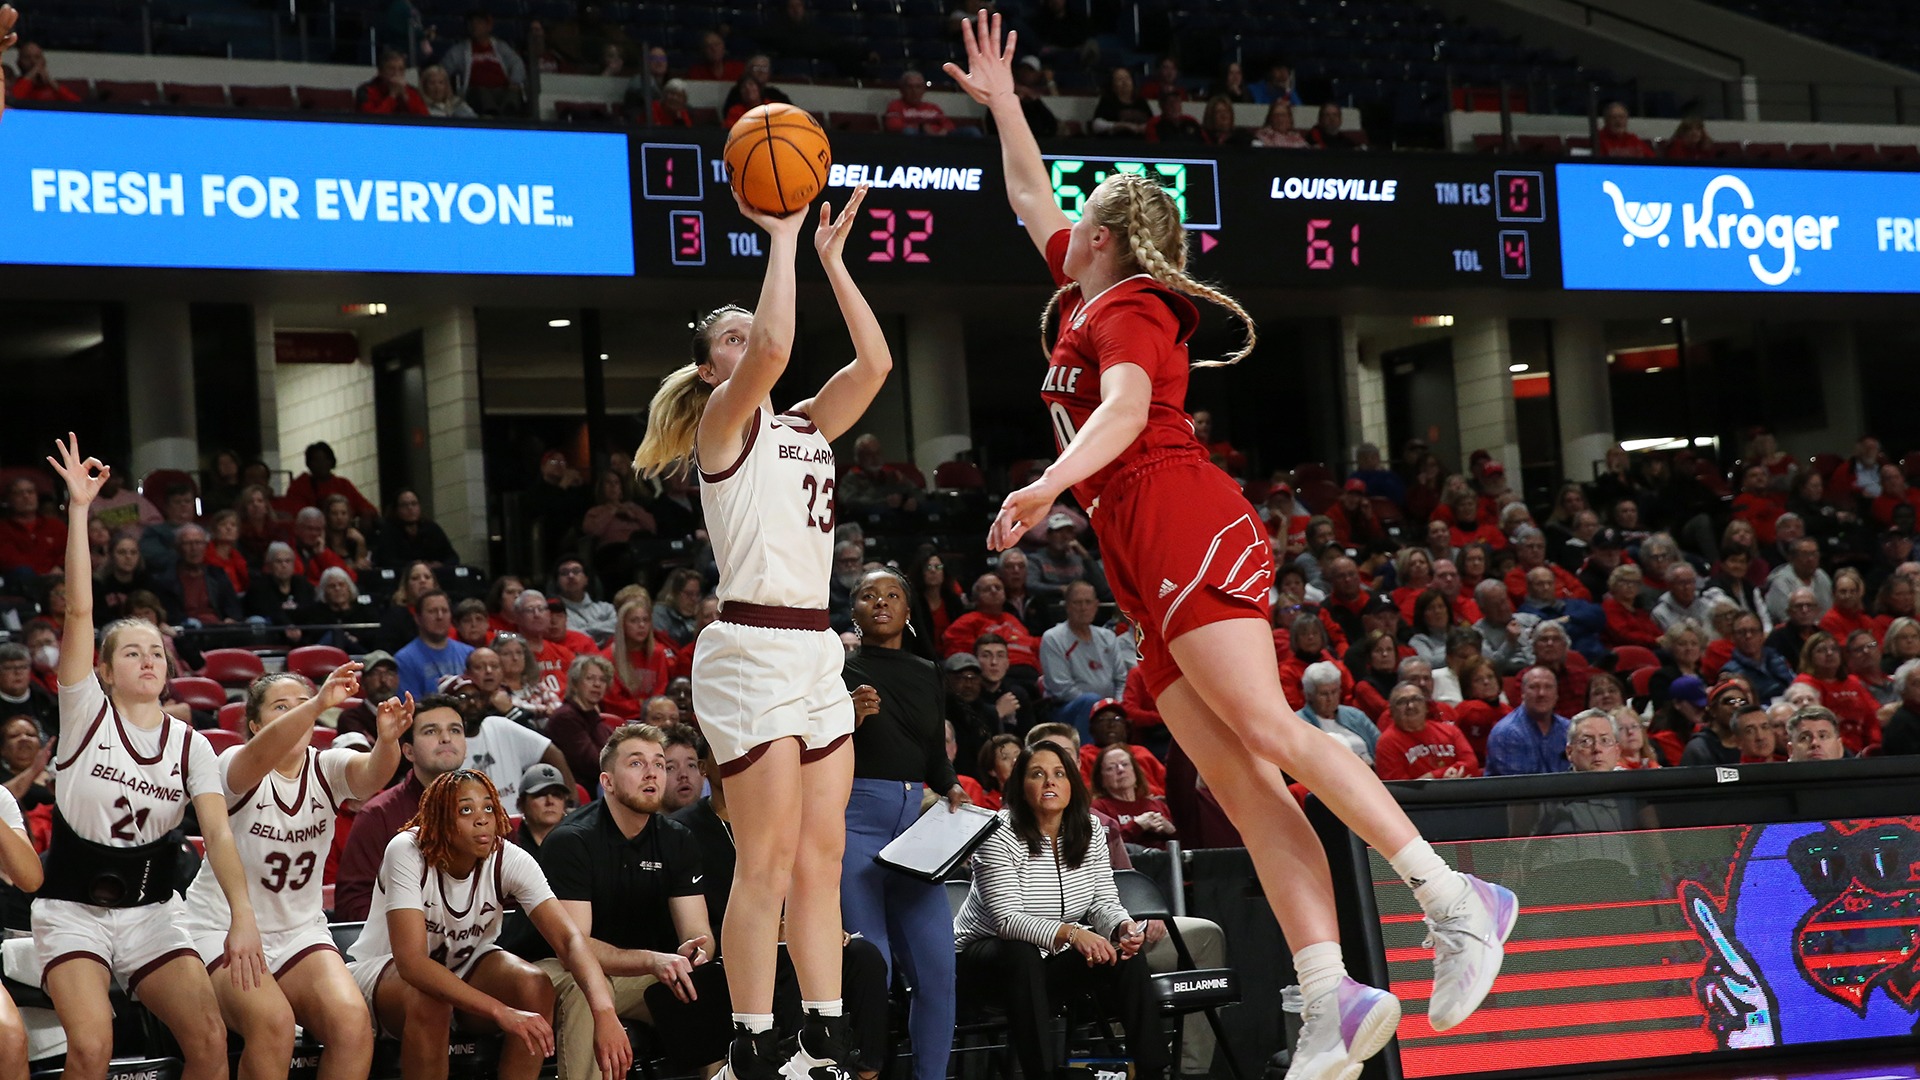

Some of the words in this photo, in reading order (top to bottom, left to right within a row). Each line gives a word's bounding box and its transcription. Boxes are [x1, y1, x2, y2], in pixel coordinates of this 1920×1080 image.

[666, 158, 673, 189] 1
[828, 164, 982, 191] BELLARMINE
[1270, 177, 1397, 202] LOUISVILLE
[31, 168, 184, 217] FRESH
[202, 174, 299, 220] FOR
[315, 178, 555, 227] EVERYONE
[1435, 183, 1459, 205] TM
[1462, 183, 1491, 206] FLS
[1509, 178, 1529, 213] 0
[681, 217, 700, 255] 3
[727, 232, 763, 256] TOL
[867, 208, 934, 263] 32
[1306, 219, 1360, 269] 61
[1682, 174, 1839, 286] Kroger
[1452, 250, 1482, 272] TOL
[1505, 241, 1525, 269] 4
[803, 474, 835, 533] 23
[91, 764, 182, 802] BELLARMINE
[111, 796, 151, 843] 21
[249, 819, 327, 843] BELLARMINE
[261, 851, 317, 893] 33
[1174, 978, 1228, 993] BELLARMINE
